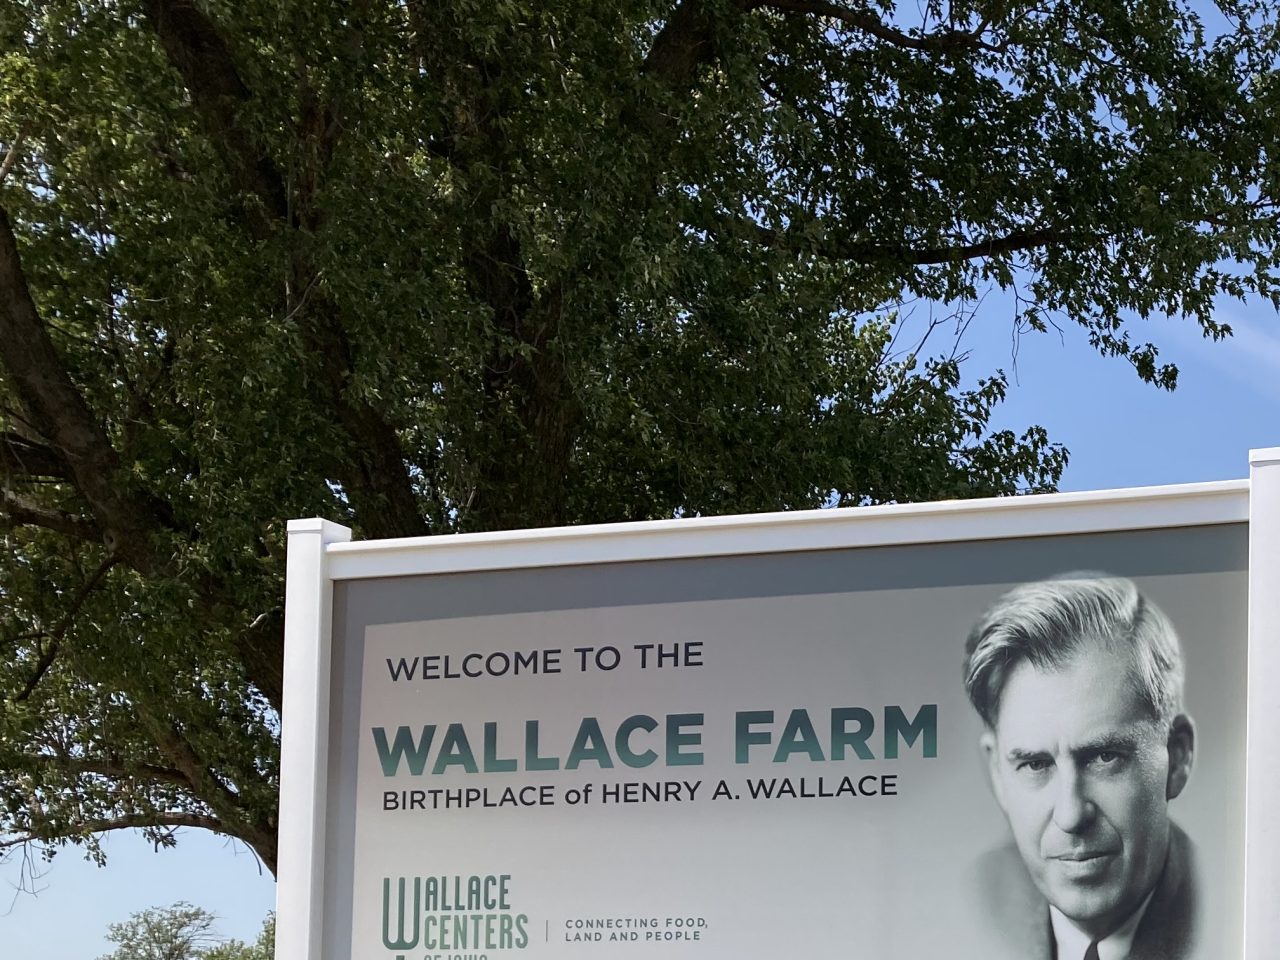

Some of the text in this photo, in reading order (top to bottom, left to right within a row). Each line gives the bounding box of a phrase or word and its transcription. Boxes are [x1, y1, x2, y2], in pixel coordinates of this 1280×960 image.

[385, 641, 704, 682] WELCOME TO THE
[371, 703, 938, 777] WALLACE FARM
[382, 774, 898, 811] BIRTHPLACE of HENRY A. WALLACE
[382, 874, 512, 951] WALLACE
[565, 917, 709, 929] CONNECTING FOOD,
[423, 913, 529, 951] CENTERS
[565, 930, 701, 942] LAND AND PEOPLE
